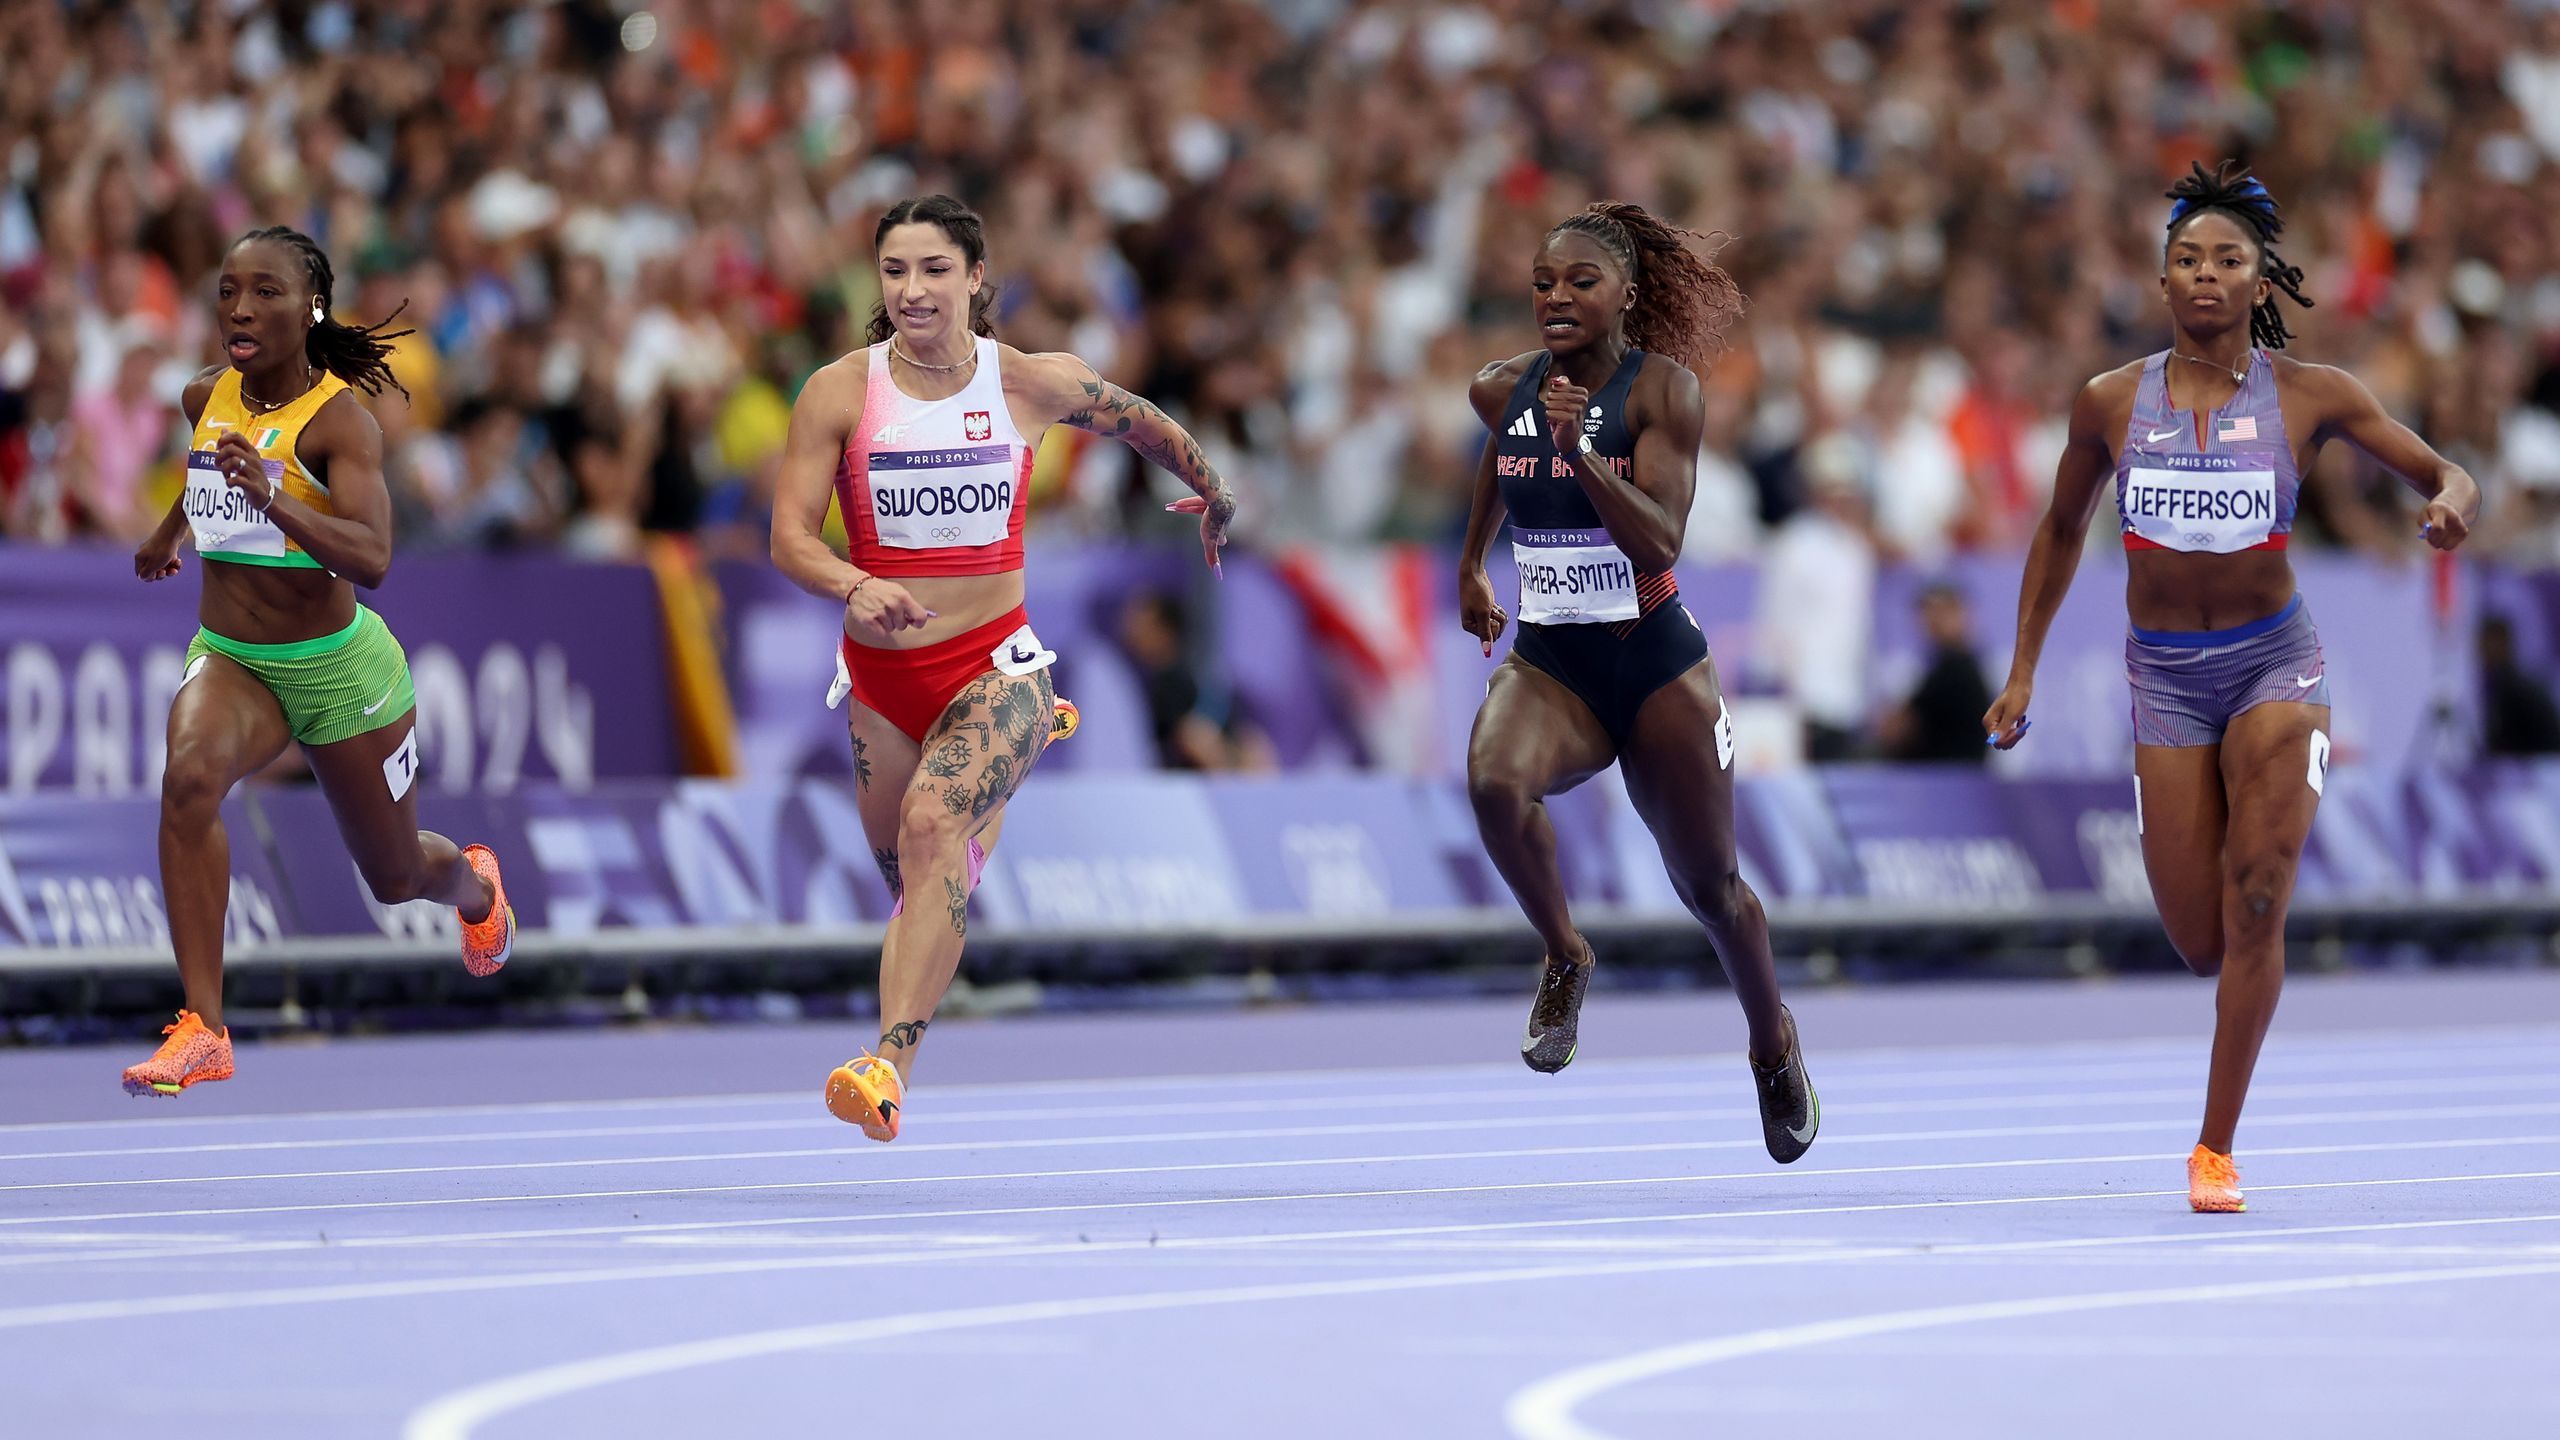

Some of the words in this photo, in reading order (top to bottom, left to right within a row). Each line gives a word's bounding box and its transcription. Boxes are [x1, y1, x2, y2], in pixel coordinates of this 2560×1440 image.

[199, 455, 216, 466] PAR
[906, 454, 942, 465] PARIS
[945, 452, 979, 463] 2024
[2167, 457, 2201, 467] PARIS
[2204, 458, 2237, 468] 2024
[876, 480, 1011, 517] SWOBODA
[2131, 486, 2270, 520] JEFFERSON
[1527, 533, 1557, 543] PARIS
[1561, 533, 1591, 543] 2024
[397, 746, 410, 778] 7
